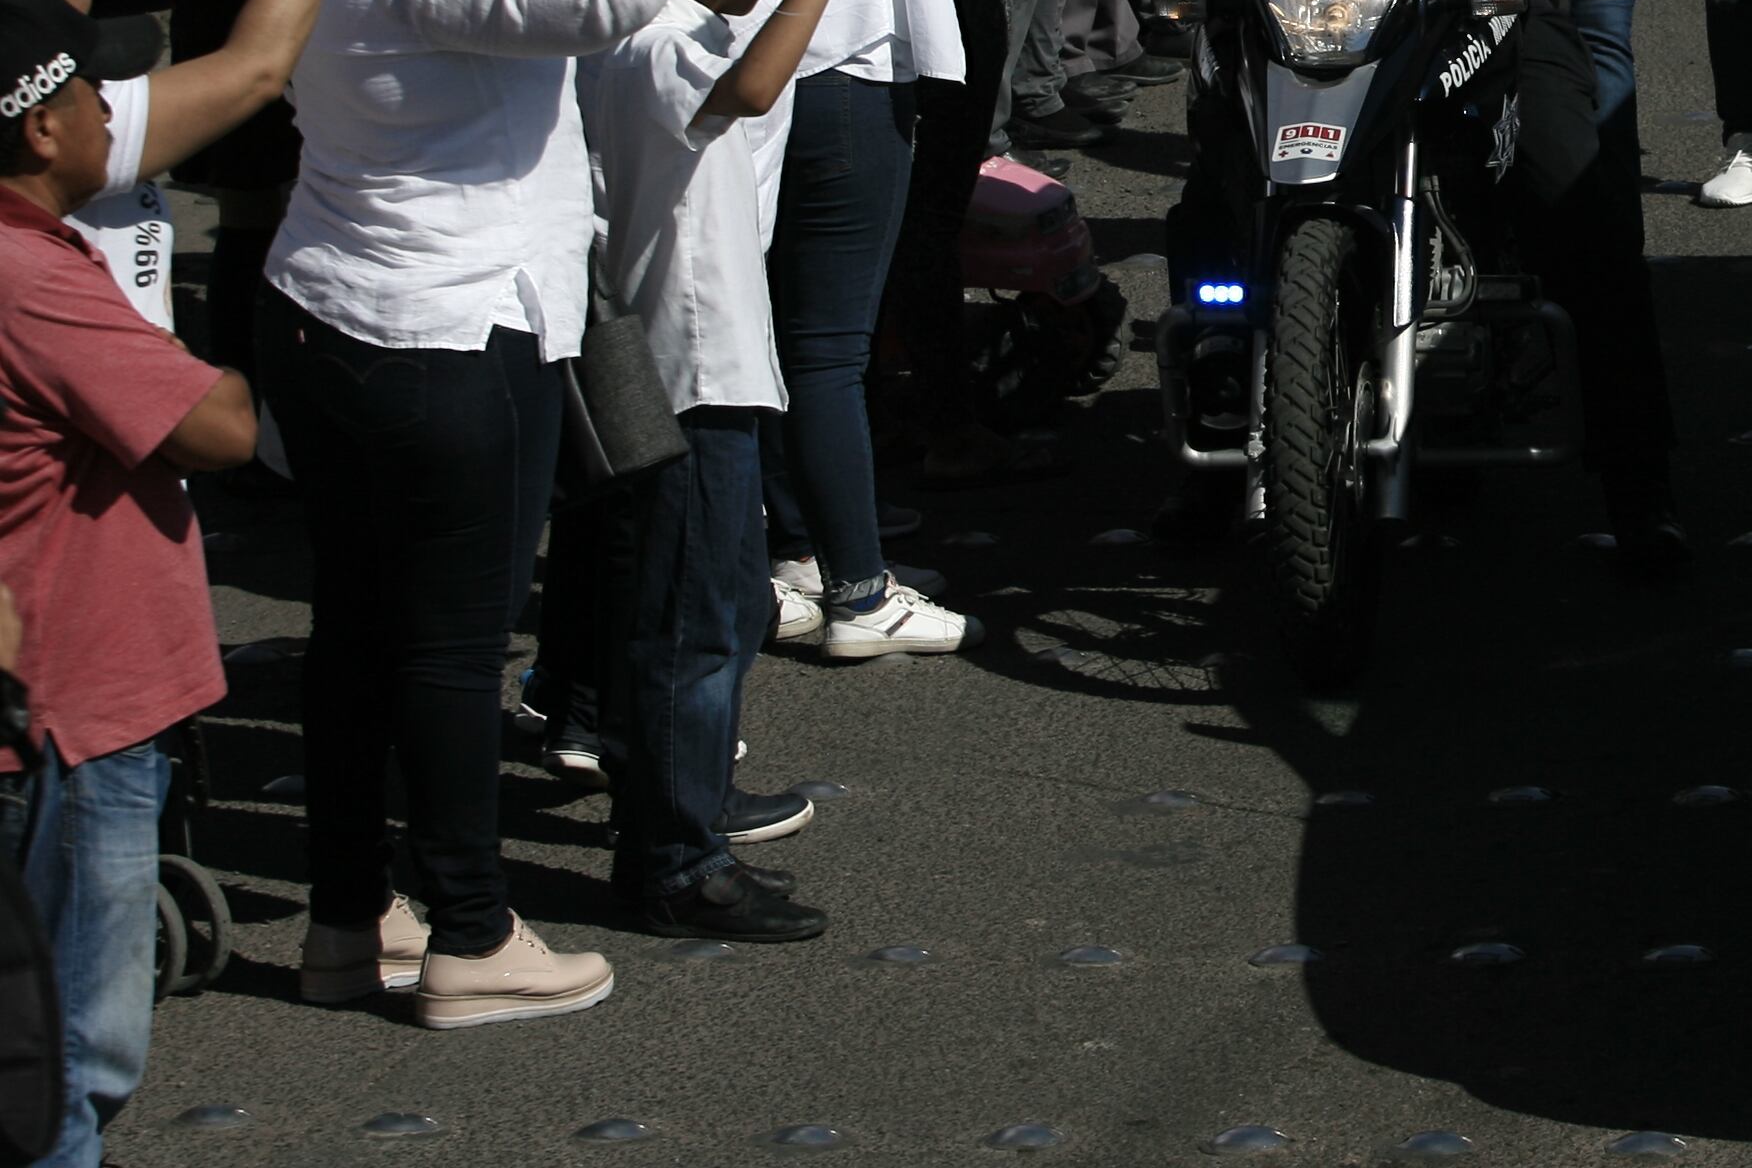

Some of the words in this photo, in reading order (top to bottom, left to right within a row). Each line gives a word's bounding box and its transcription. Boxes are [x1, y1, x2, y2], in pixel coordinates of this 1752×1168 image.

[0, 52, 77, 118] adidas
[1286, 127, 1335, 139] 911
[135, 223, 161, 288] 99%
